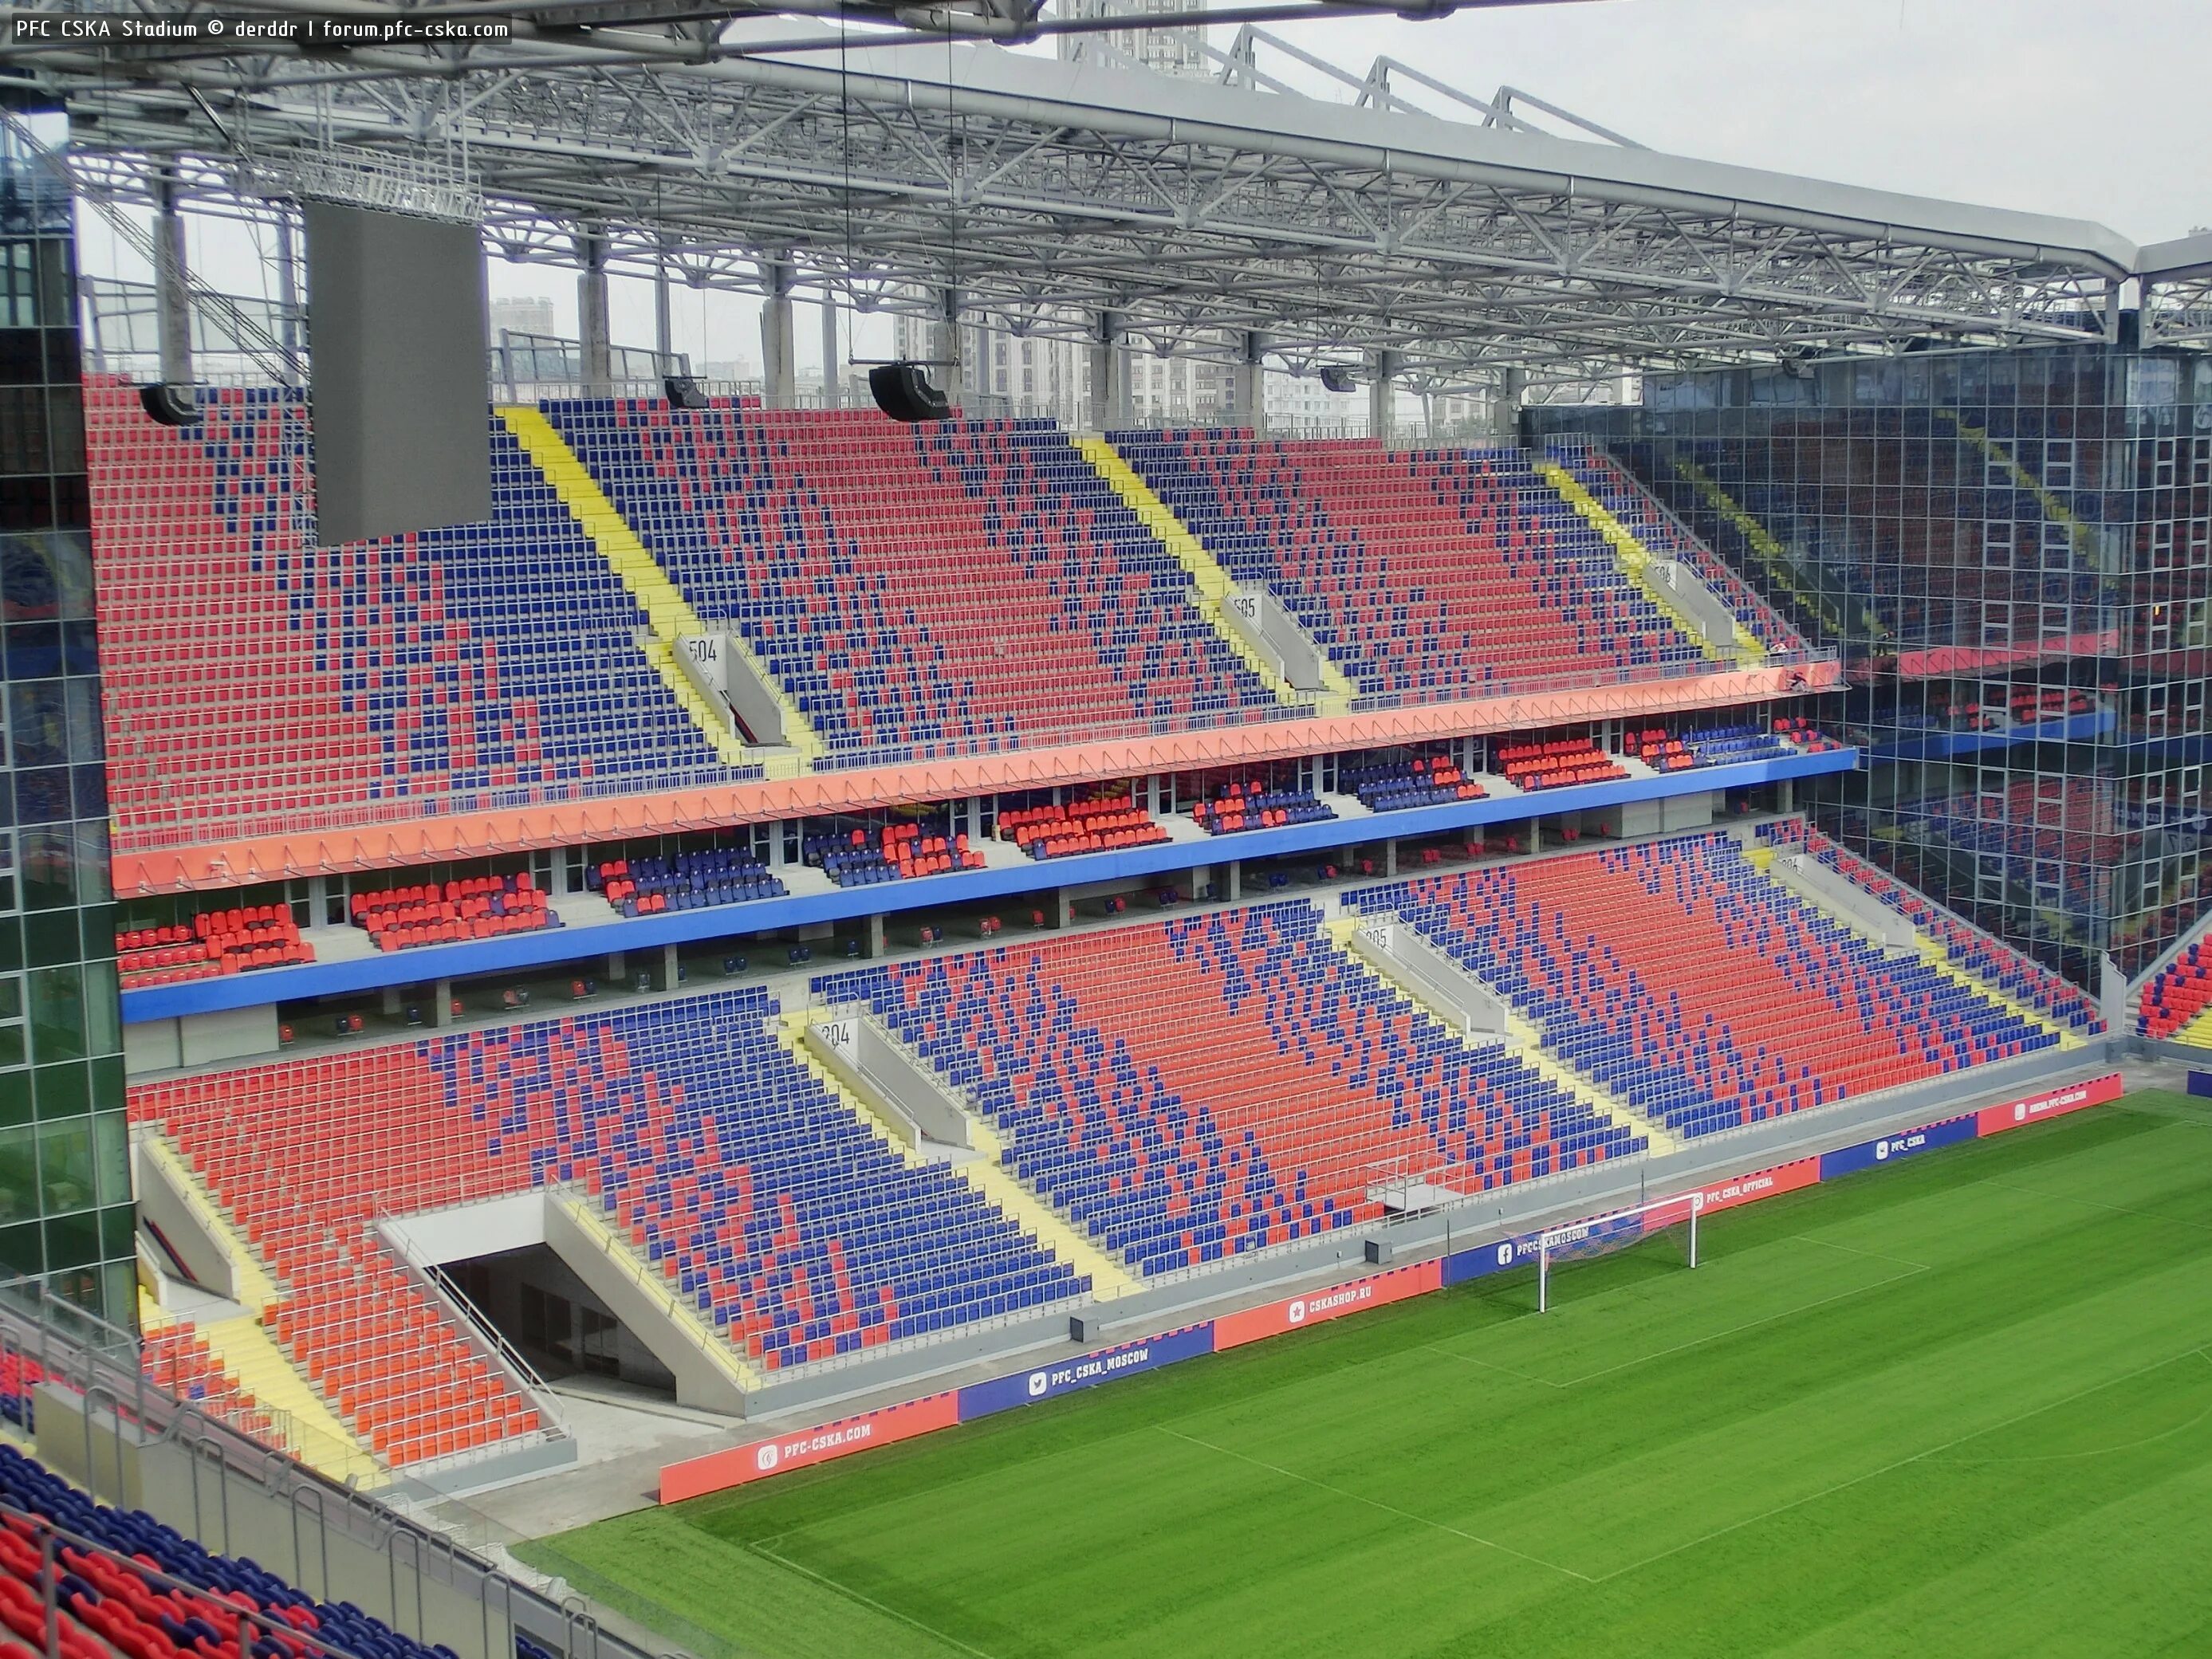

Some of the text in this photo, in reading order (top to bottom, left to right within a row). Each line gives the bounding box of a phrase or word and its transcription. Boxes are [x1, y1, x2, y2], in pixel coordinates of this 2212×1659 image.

[1234, 598, 1255, 618] 505
[689, 639, 717, 662] 504
[821, 1022, 850, 1047] 204
[1706, 1177, 1773, 1203] PFC_CSKA_OFFICIAL
[1309, 1286, 1372, 1313] CSKASHOP.RU
[1051, 1348, 1149, 1386] PFC_CSKA_MOSCOW
[784, 1424, 872, 1459] PFC-CSKA.COM
